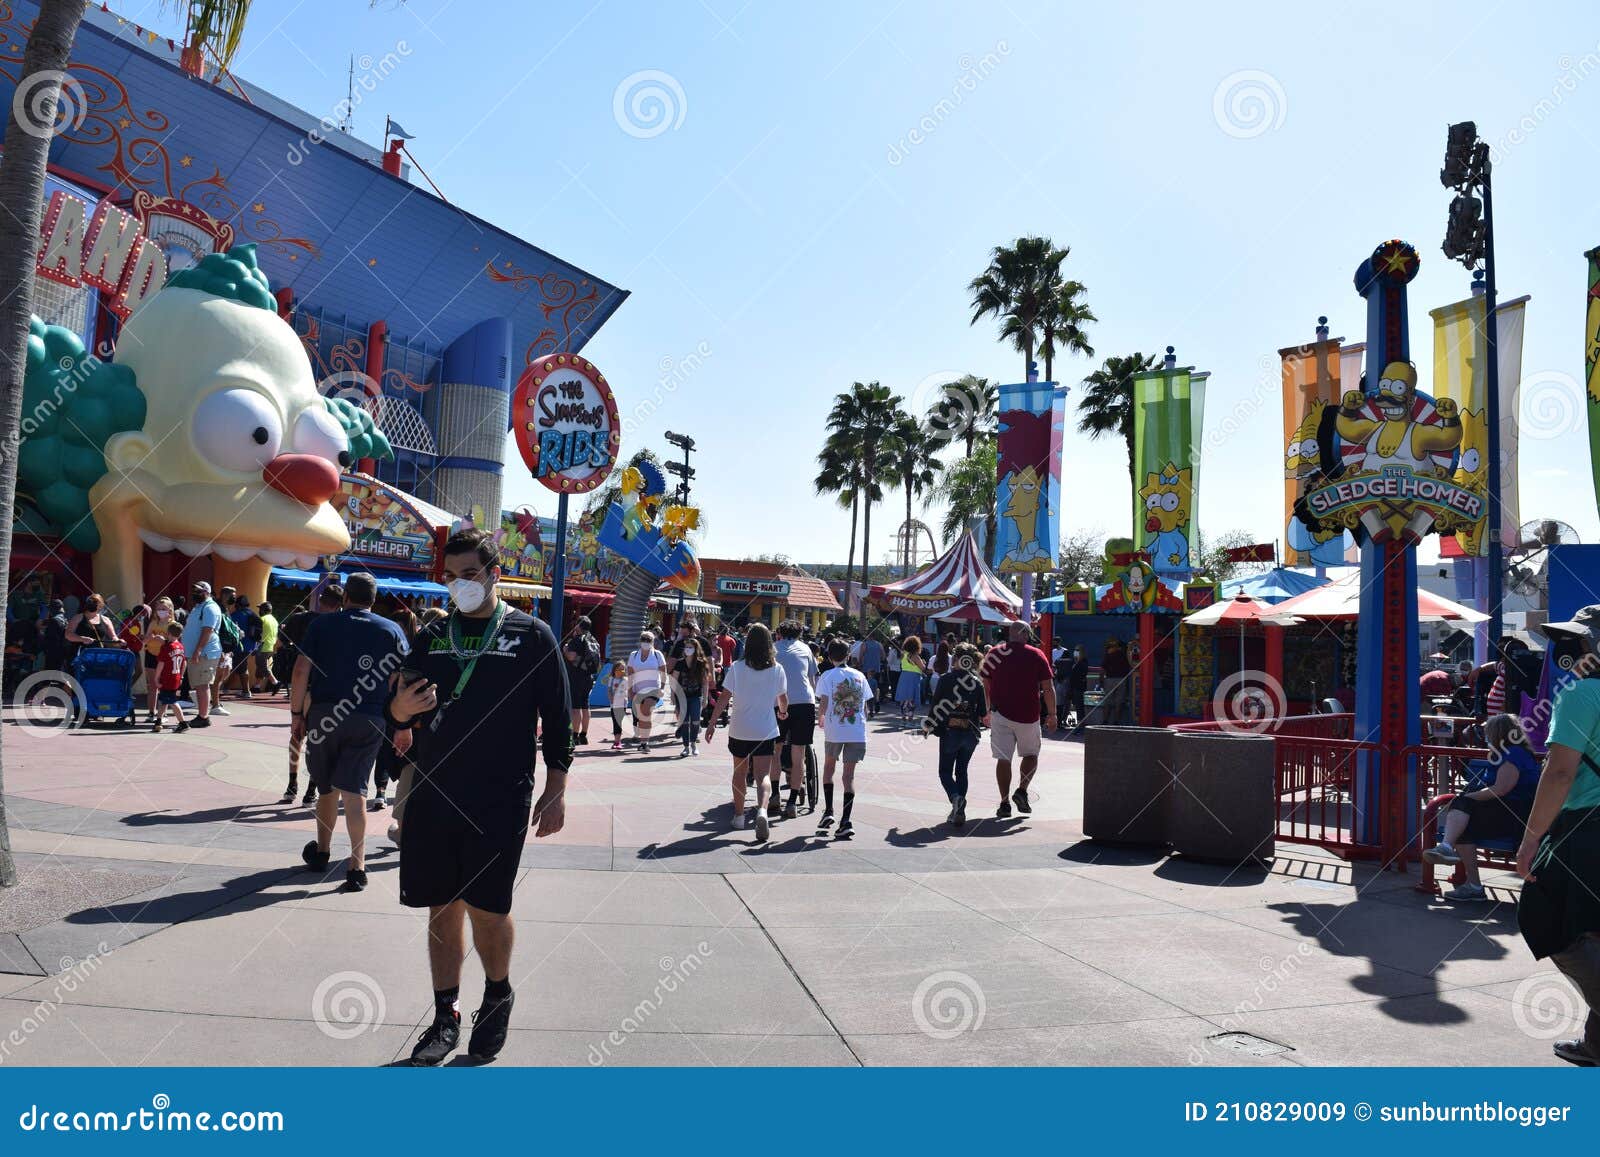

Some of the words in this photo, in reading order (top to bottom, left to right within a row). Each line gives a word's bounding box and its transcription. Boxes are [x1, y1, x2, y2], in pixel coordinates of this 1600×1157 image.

[559, 380, 584, 399] THE
[533, 429, 611, 478] RIDE
[1386, 468, 1407, 477] THE
[1311, 478, 1398, 513] SLEDGE
[1402, 478, 1482, 517] HOMER
[370, 540, 410, 557] HELPER
[725, 580, 784, 593] KWIK-E-MART
[892, 596, 915, 608] HOT
[917, 598, 953, 610] DOGS!
